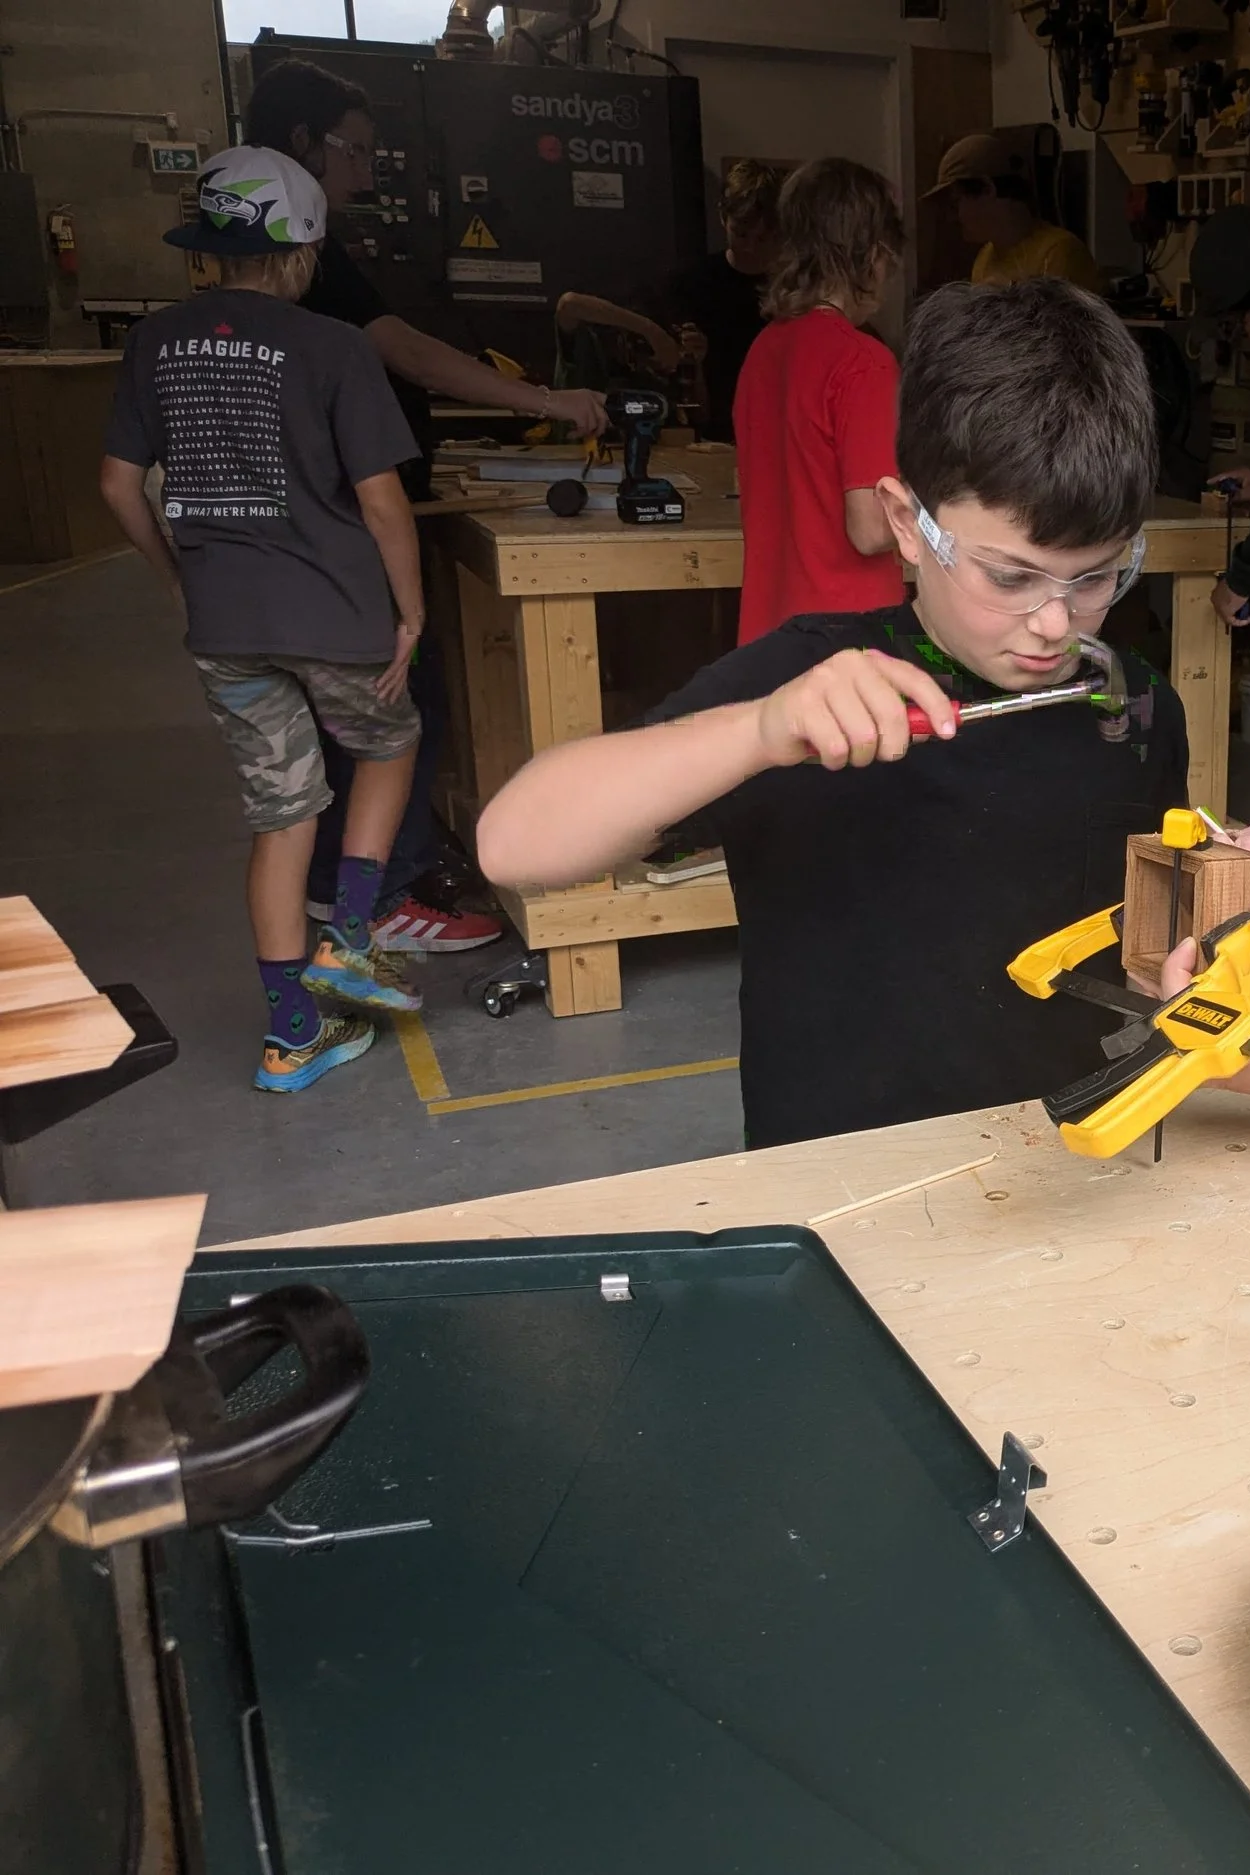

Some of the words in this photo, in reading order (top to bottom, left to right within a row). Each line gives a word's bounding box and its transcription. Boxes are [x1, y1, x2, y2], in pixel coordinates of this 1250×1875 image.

[568, 137, 645, 166] scm
[158, 343, 168, 360] A
[174, 338, 252, 358] LEAGUE
[257, 345, 286, 366] OF
[187, 506, 211, 517] WHAT
[212, 506, 246, 517] WE'RE
[249, 506, 280, 517] MADE
